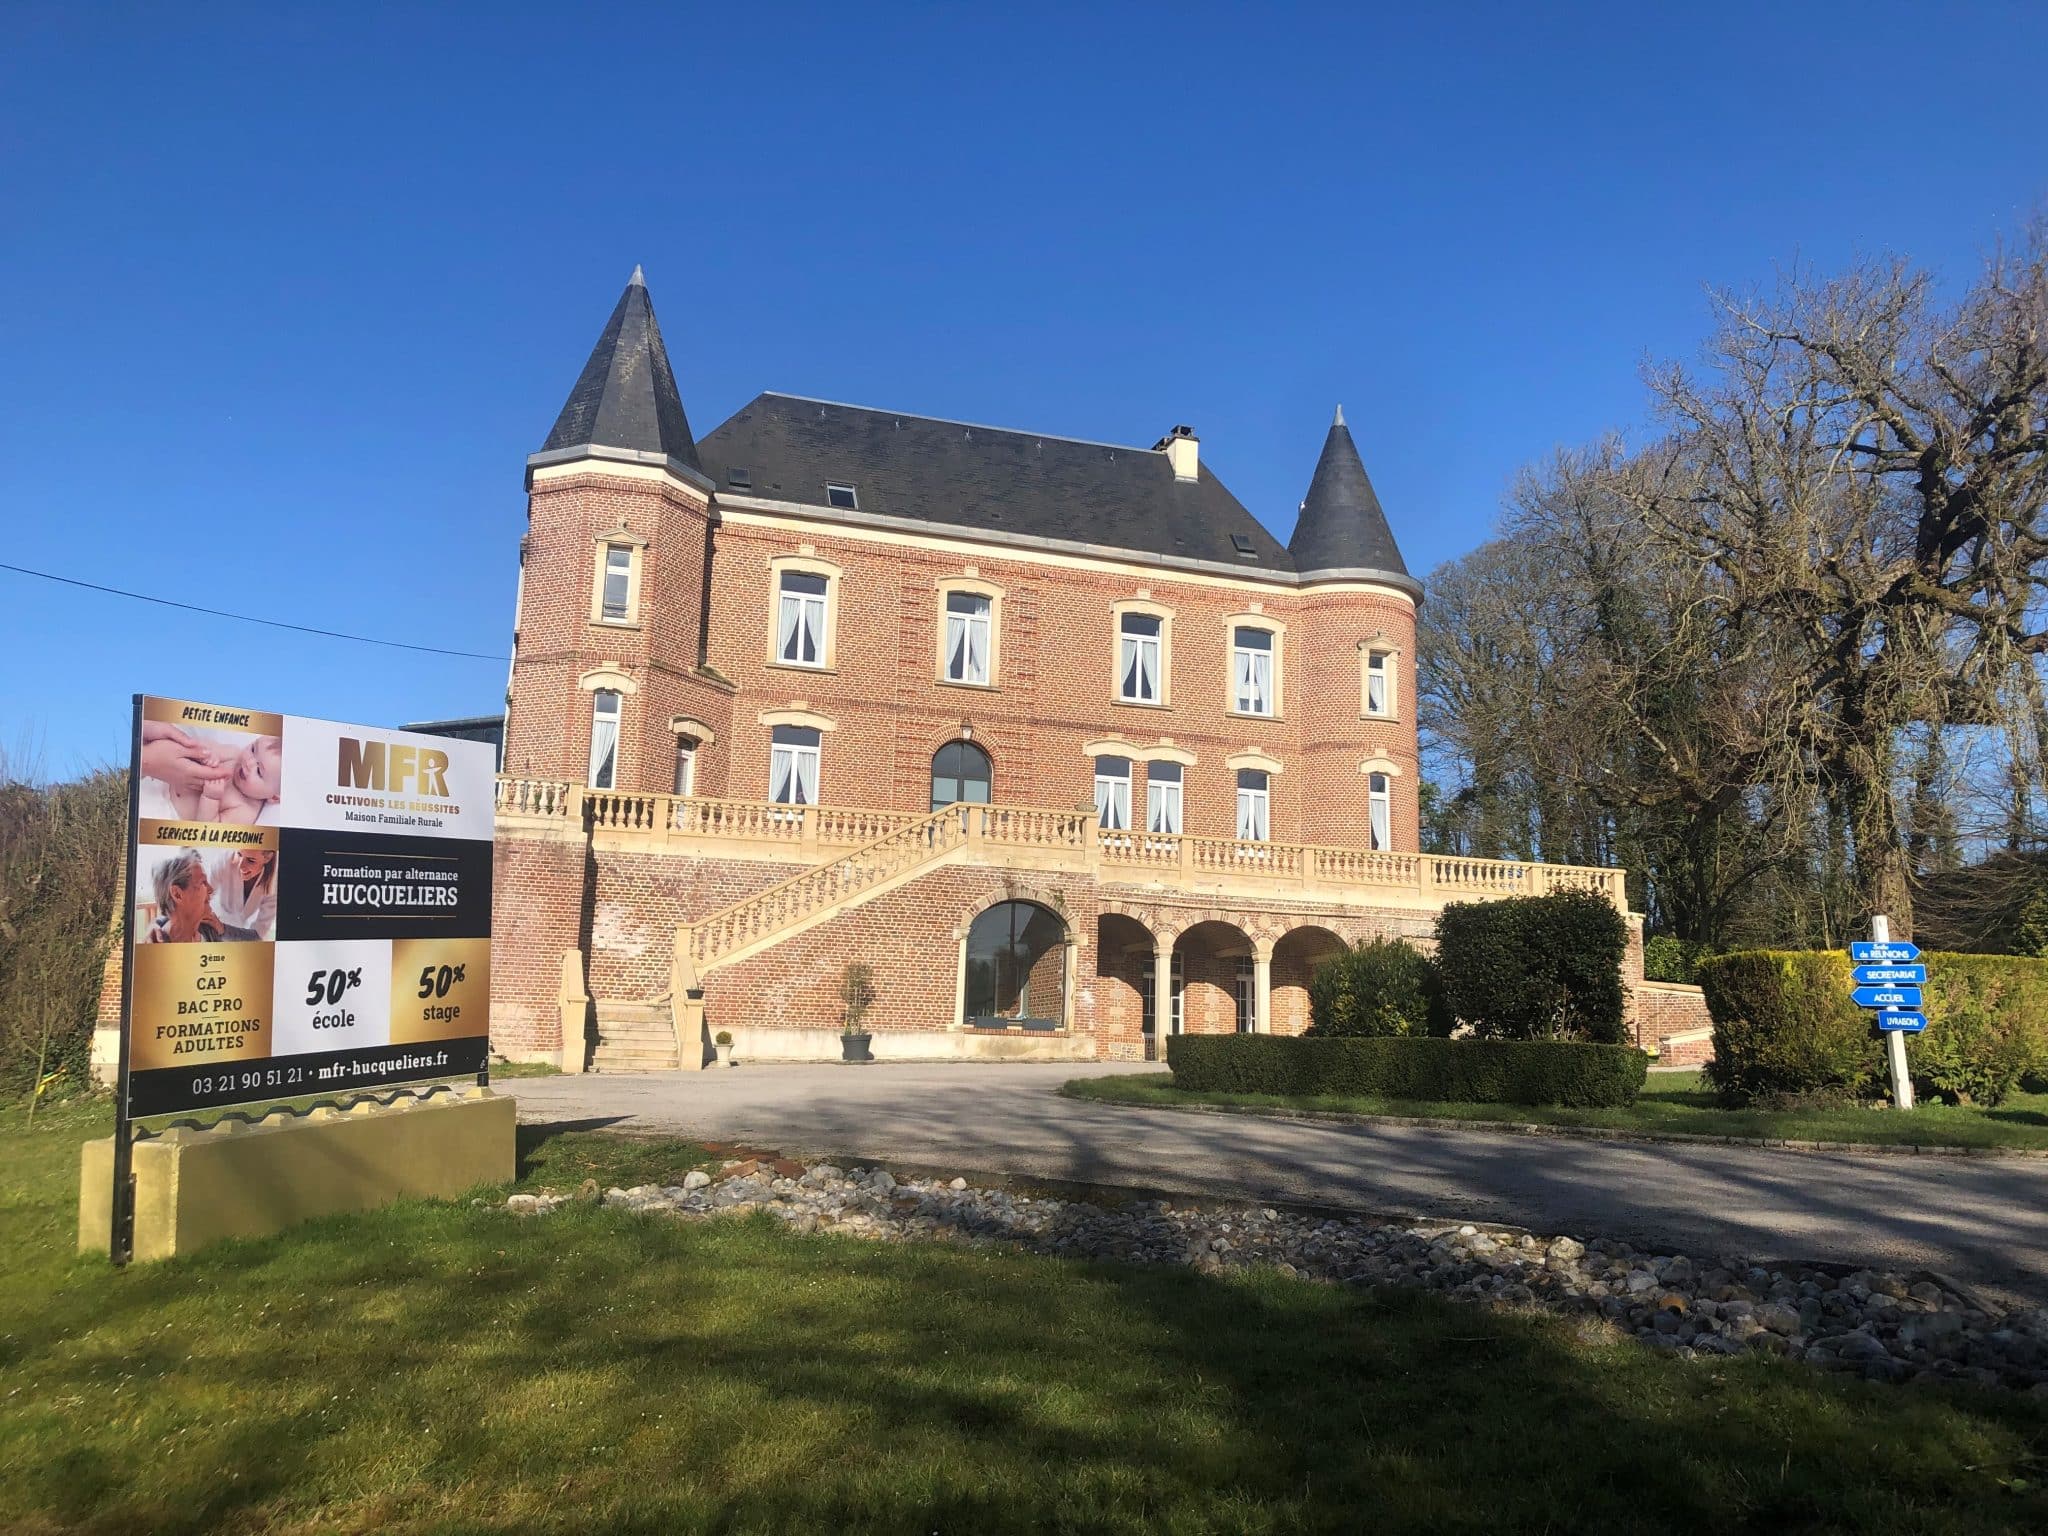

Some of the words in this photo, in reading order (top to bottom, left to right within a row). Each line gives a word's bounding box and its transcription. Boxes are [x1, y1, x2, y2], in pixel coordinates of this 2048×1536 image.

[214, 711, 250, 727] ENFANCE
[338, 737, 450, 797] MFR
[326, 794, 385, 808] CULTIVONS
[388, 800, 406, 810] LES
[345, 811, 376, 822] Maison
[378, 814, 416, 826] Familiale
[418, 817, 443, 828] Rurale
[200, 826, 206, 842] À
[209, 829, 220, 842] LA
[222, 830, 264, 844] PERSONNE
[323, 864, 382, 880] Formation
[384, 869, 403, 883] par
[405, 868, 458, 882] alternance
[322, 883, 458, 908] HUCQUELIERS
[196, 977, 227, 991] CAP
[305, 967, 362, 1006] 50%
[417, 963, 465, 999] 50%
[177, 1001, 209, 1015] BAC
[213, 998, 243, 1013] PRO
[1874, 994, 1905, 1002] ACCUEIL
[312, 1010, 355, 1030] école
[423, 1005, 461, 1023] stage
[1887, 1017, 1919, 1026] LIVRAISONS
[156, 1019, 261, 1040] FORMATIONS
[173, 1036, 244, 1054] ADULTES
[192, 1078, 213, 1095] 03
[217, 1074, 235, 1091] 21
[241, 1072, 261, 1089] 90
[266, 1070, 282, 1086] 51
[287, 1067, 303, 1083] 21
[318, 1052, 449, 1080] mfr-hucqueliers.fr
